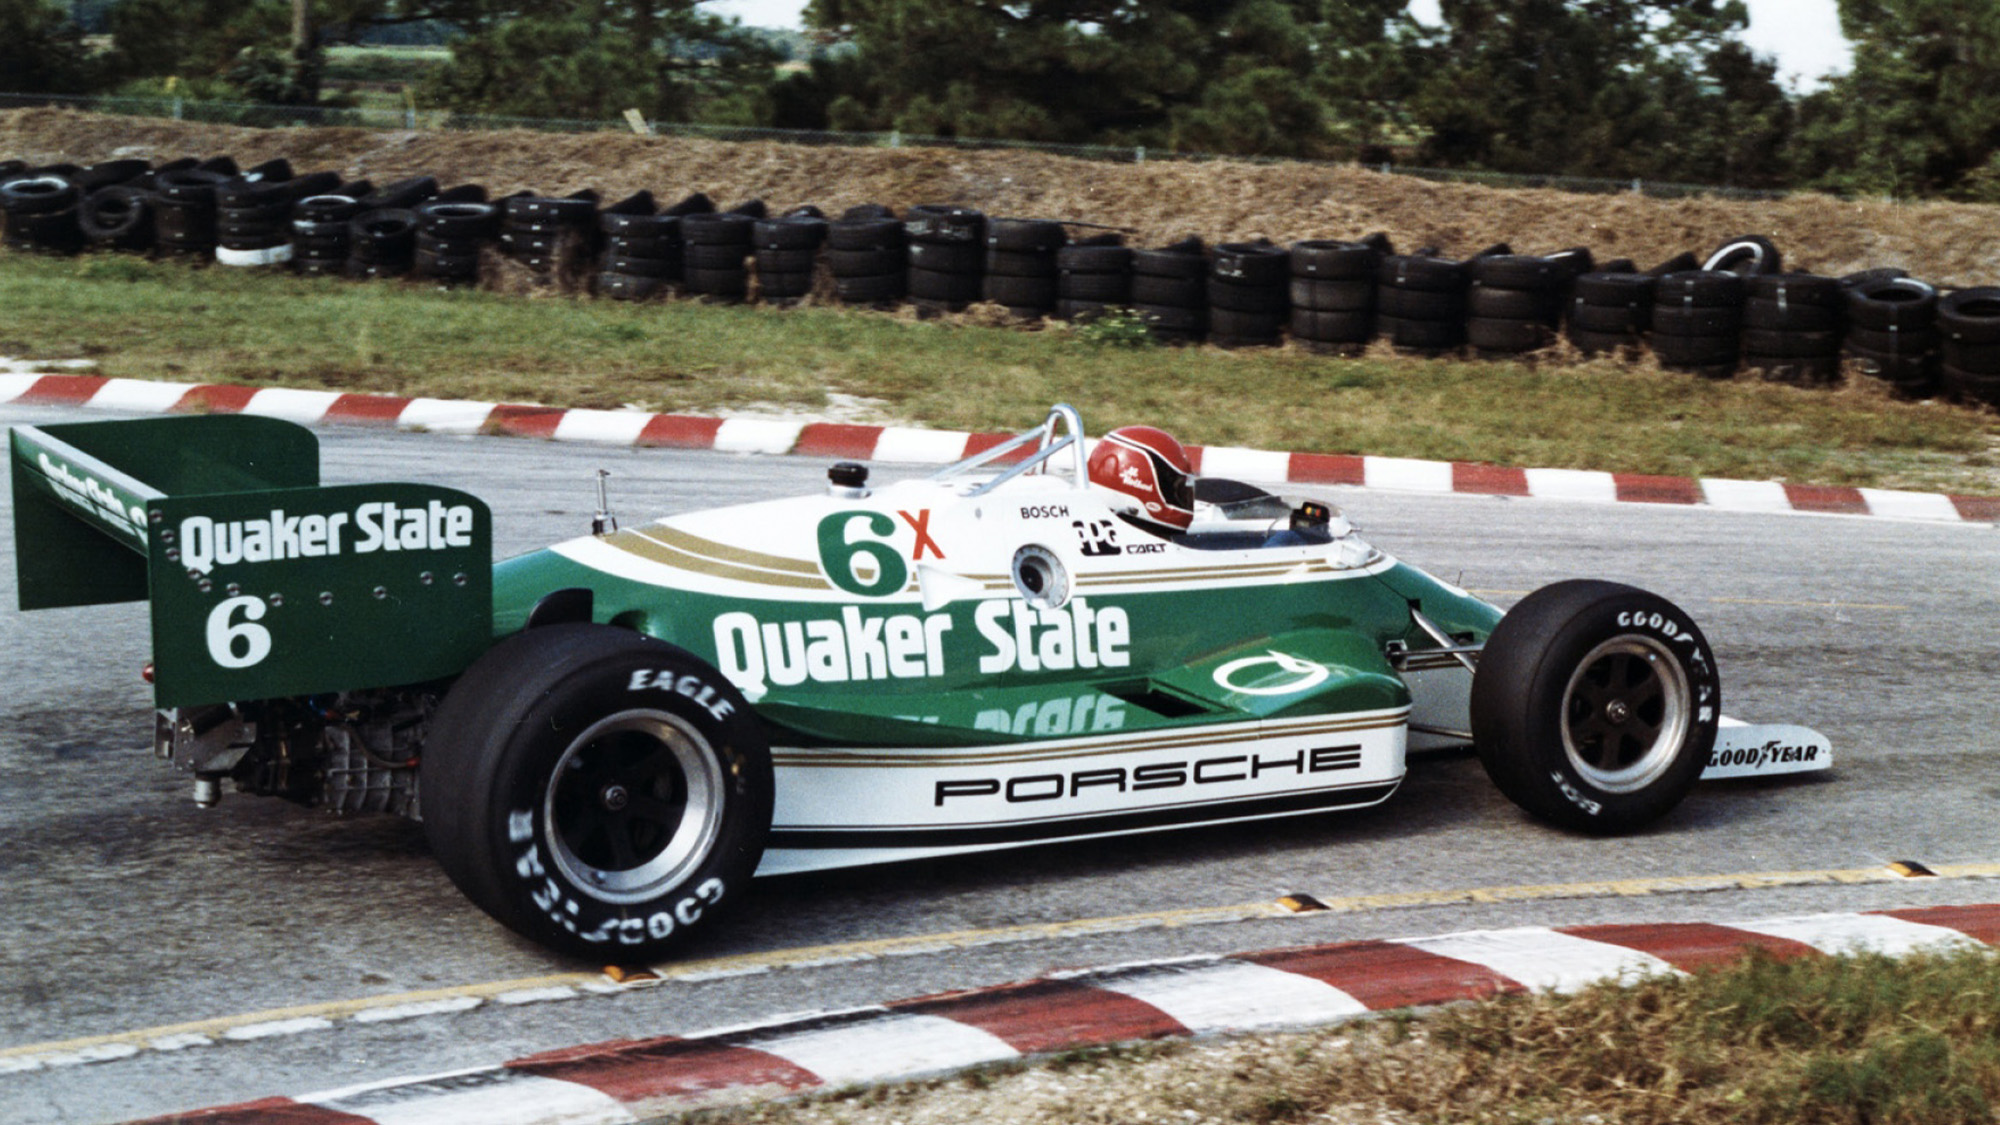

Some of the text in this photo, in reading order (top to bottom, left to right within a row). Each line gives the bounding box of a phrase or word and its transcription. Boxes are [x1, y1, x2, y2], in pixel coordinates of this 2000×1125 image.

[180, 509, 348, 575] Quaker
[355, 500, 473, 553] State
[1020, 505, 1069, 519] BOSCH
[1072, 519, 1122, 557] PPG
[1126, 543, 1167, 554] CART
[206, 595, 272, 669] 6
[712, 597, 1131, 701] Quaker State
[627, 668, 737, 722] EAGLE
[934, 743, 1362, 807] PORSCHE
